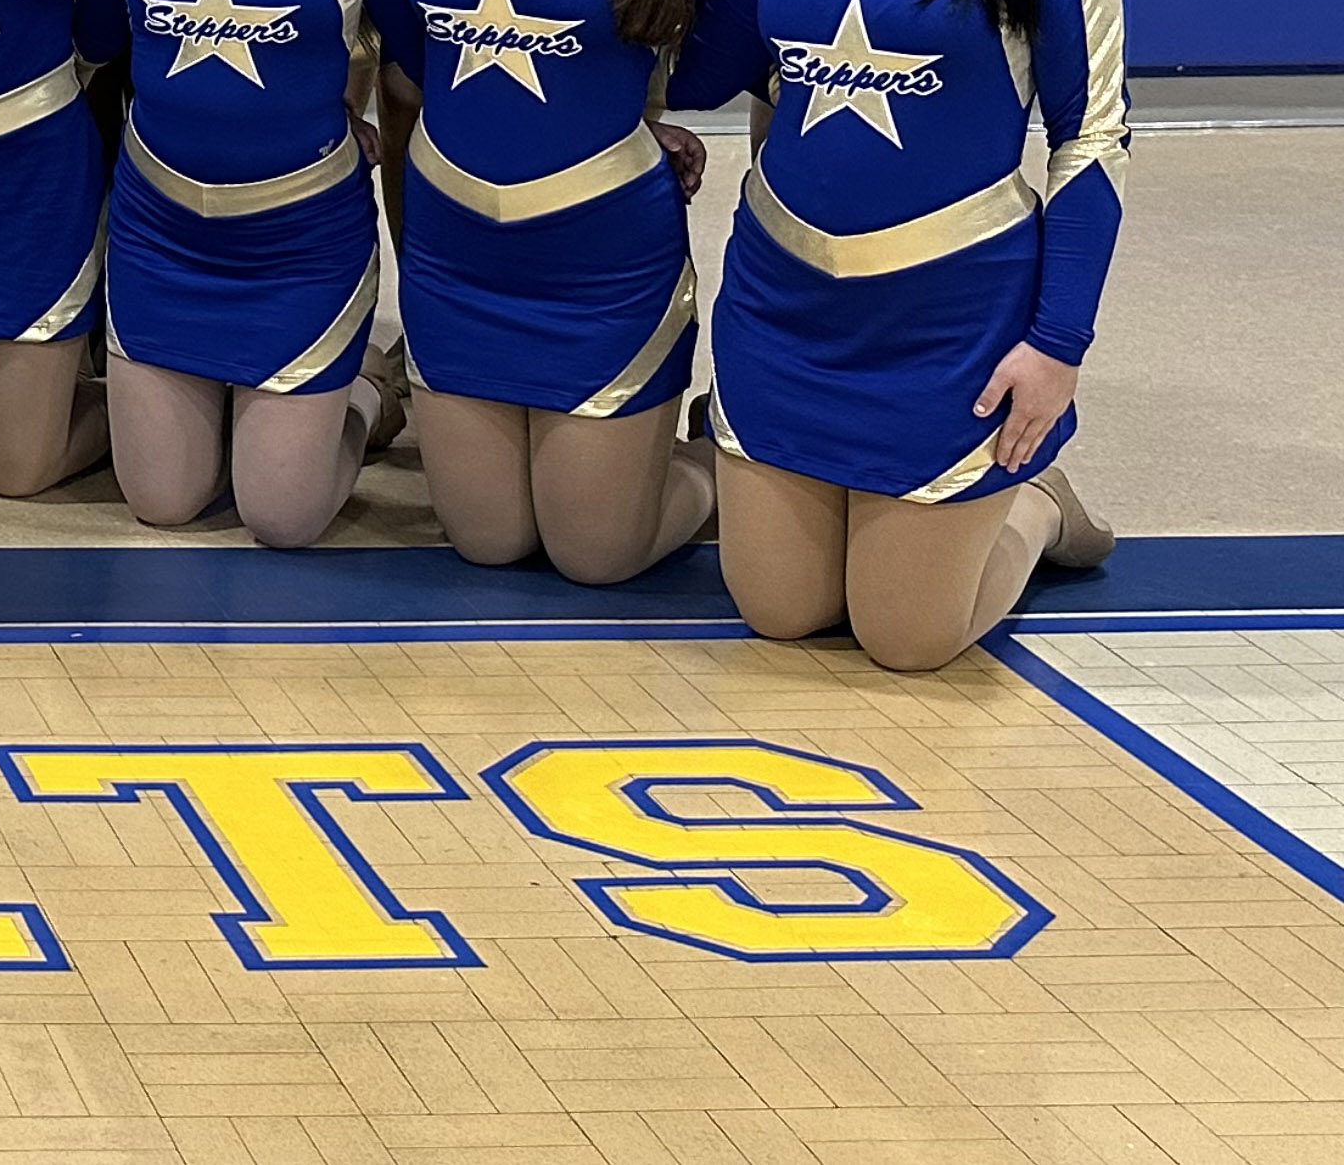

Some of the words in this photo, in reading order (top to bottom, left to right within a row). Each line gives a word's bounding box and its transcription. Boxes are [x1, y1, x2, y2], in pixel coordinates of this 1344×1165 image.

[144, 4, 299, 46] Steppers
[424, 11, 584, 57] Steppers
[778, 47, 943, 97] Steppers
